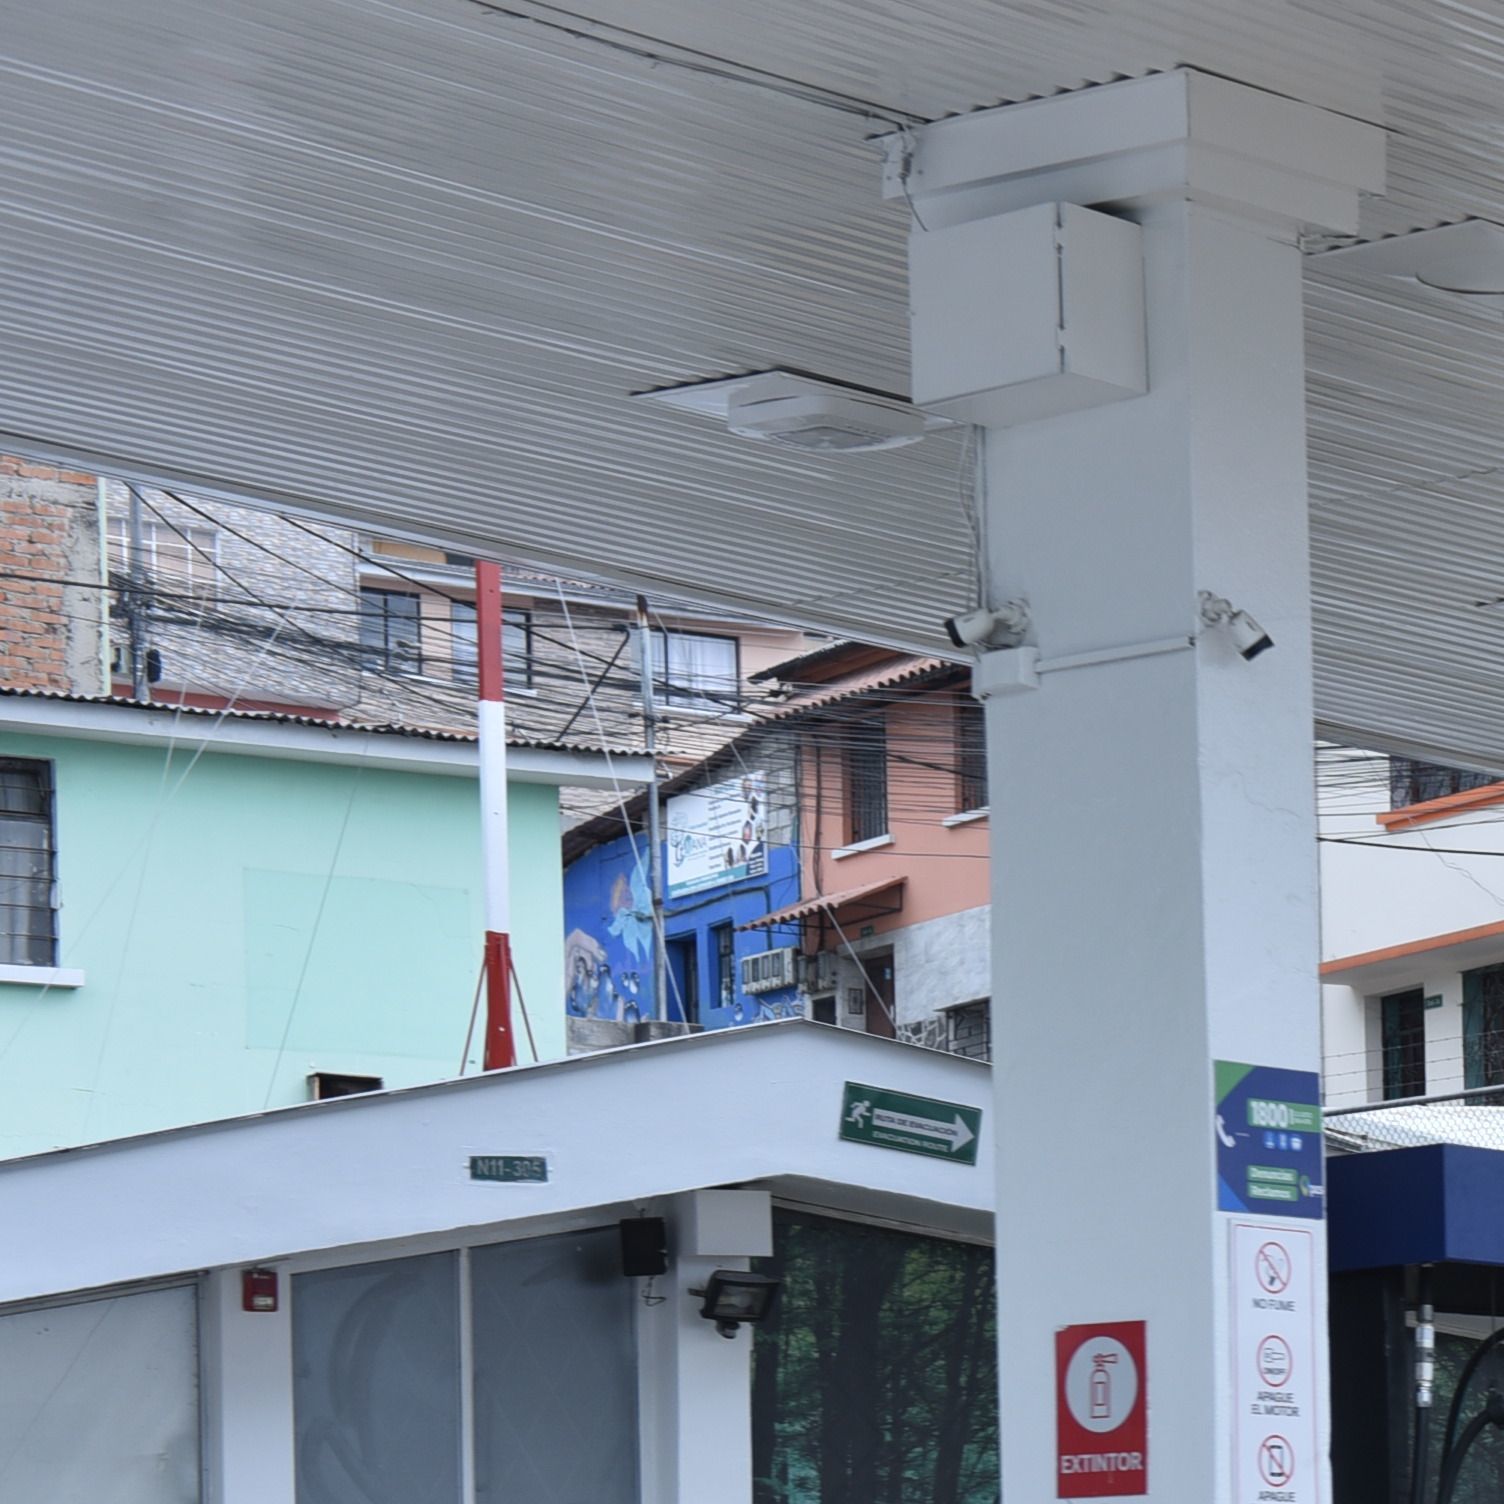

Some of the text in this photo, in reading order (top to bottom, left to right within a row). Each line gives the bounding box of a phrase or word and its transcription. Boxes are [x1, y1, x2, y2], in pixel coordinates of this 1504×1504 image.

[1251, 1100, 1289, 1129] 1800
[1264, 1405, 1301, 1417] MOTOR
[1060, 1451, 1145, 1475] EXTINTOR
